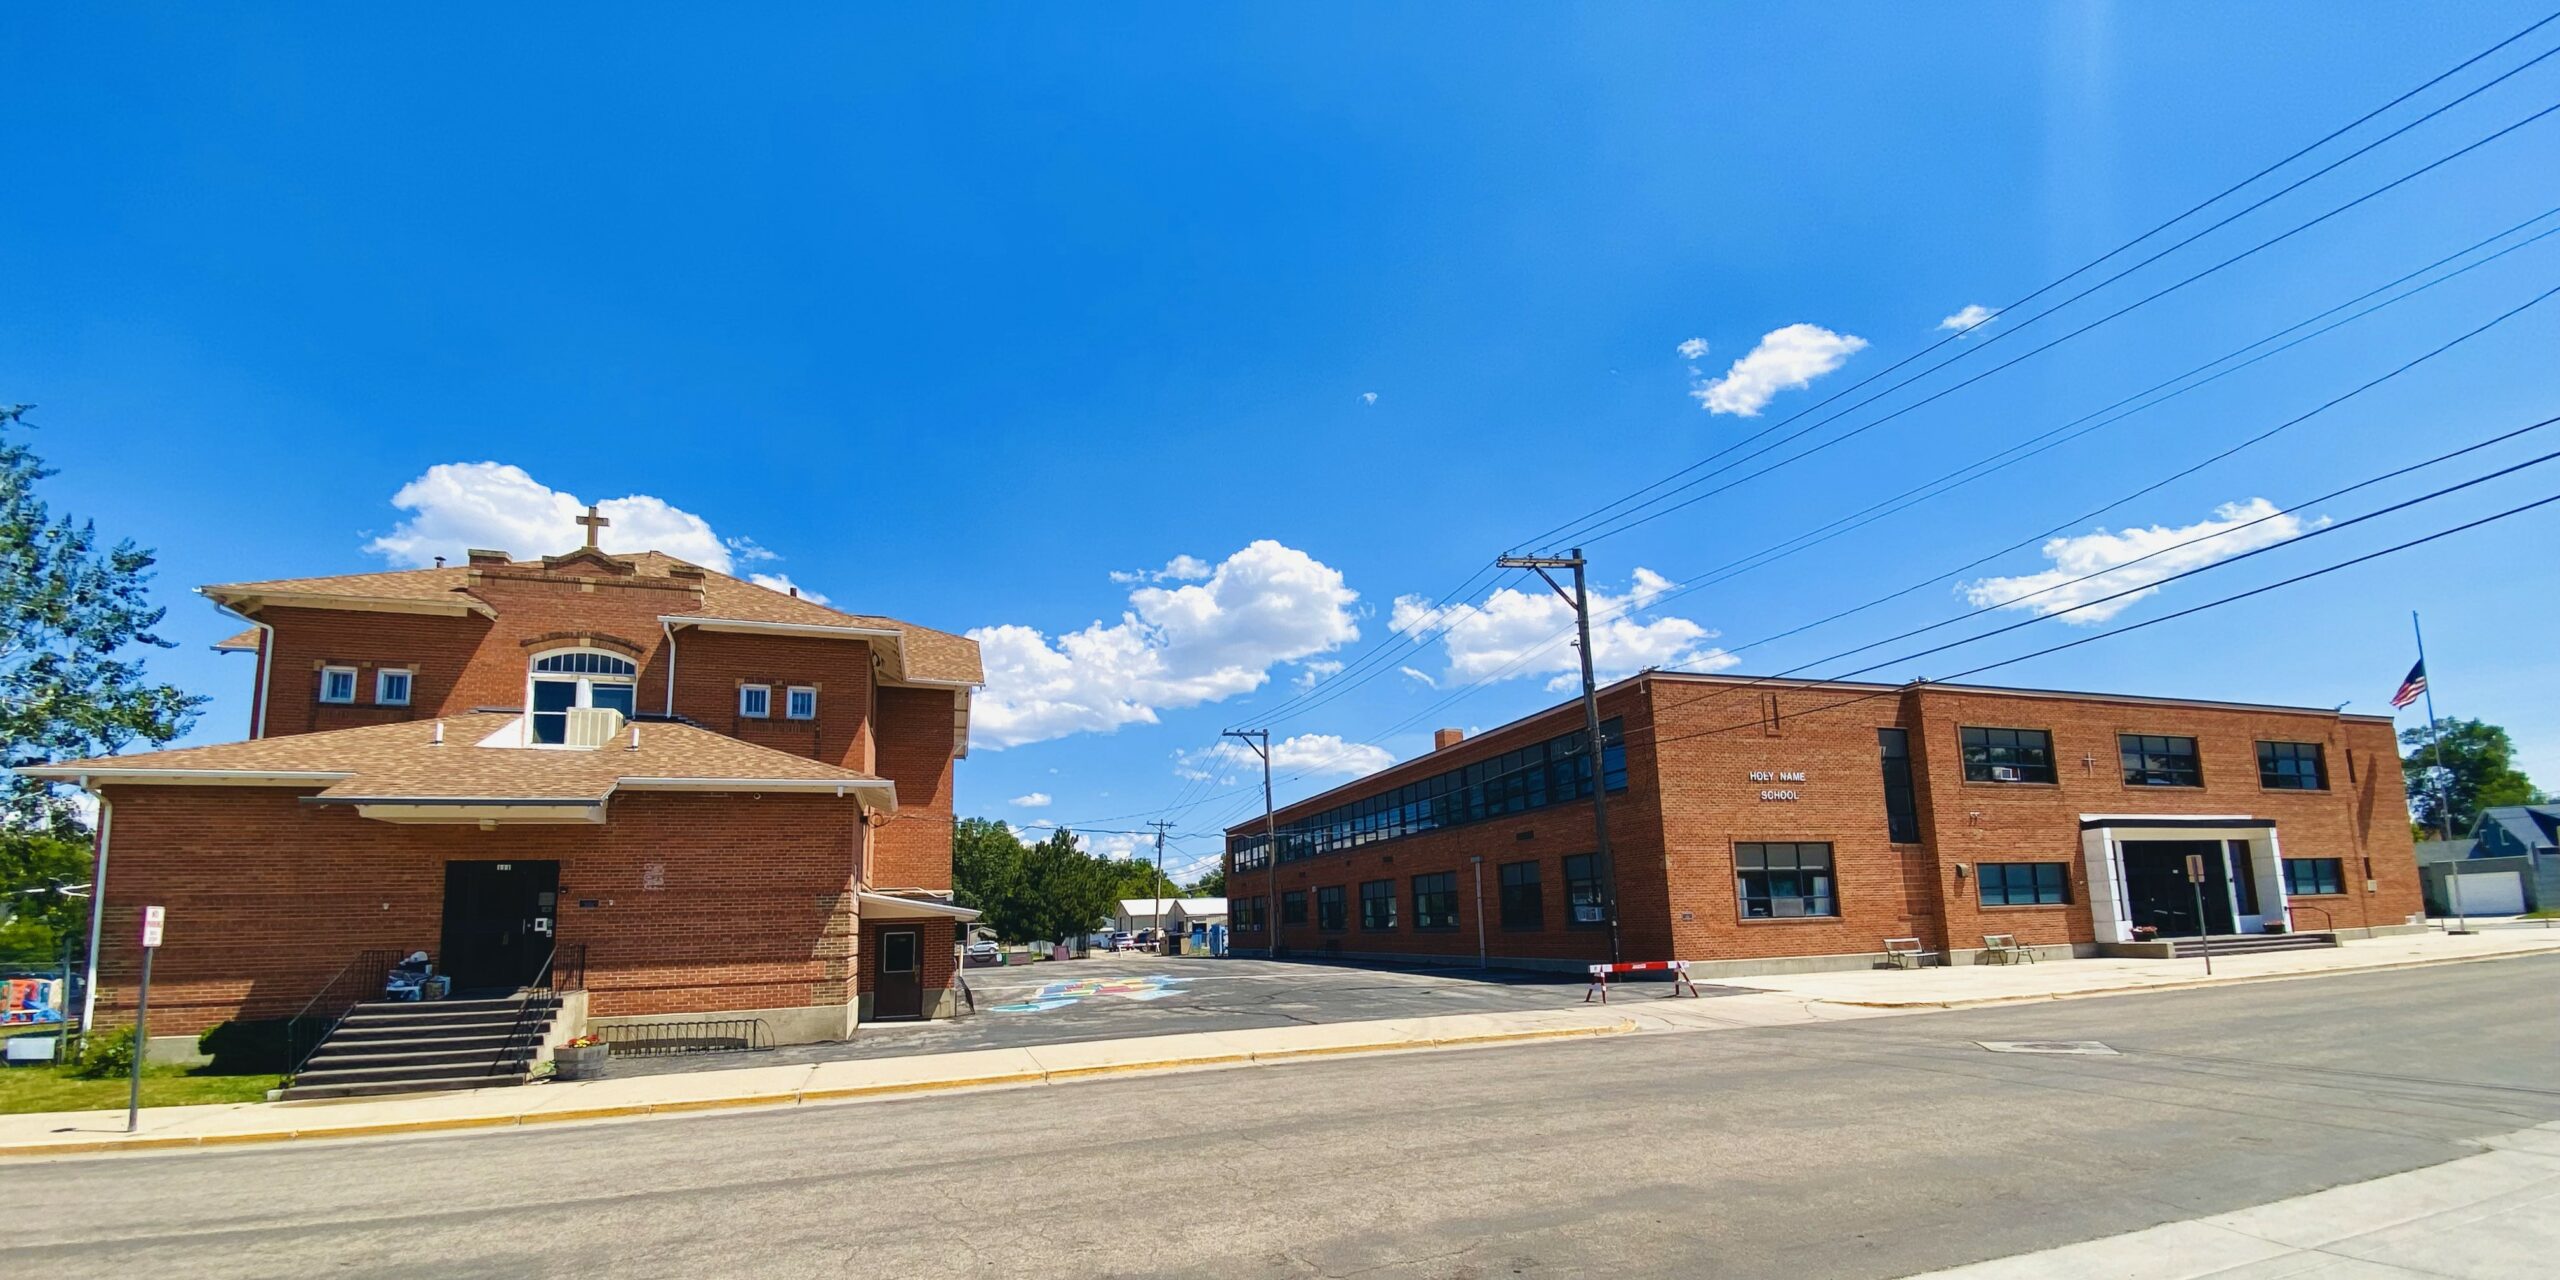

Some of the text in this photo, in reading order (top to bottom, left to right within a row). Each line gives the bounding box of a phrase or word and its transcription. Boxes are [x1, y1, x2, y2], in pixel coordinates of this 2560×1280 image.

[1749, 771, 1806, 781] HOLY NAME
[1761, 790, 1799, 800] SCHOOL
